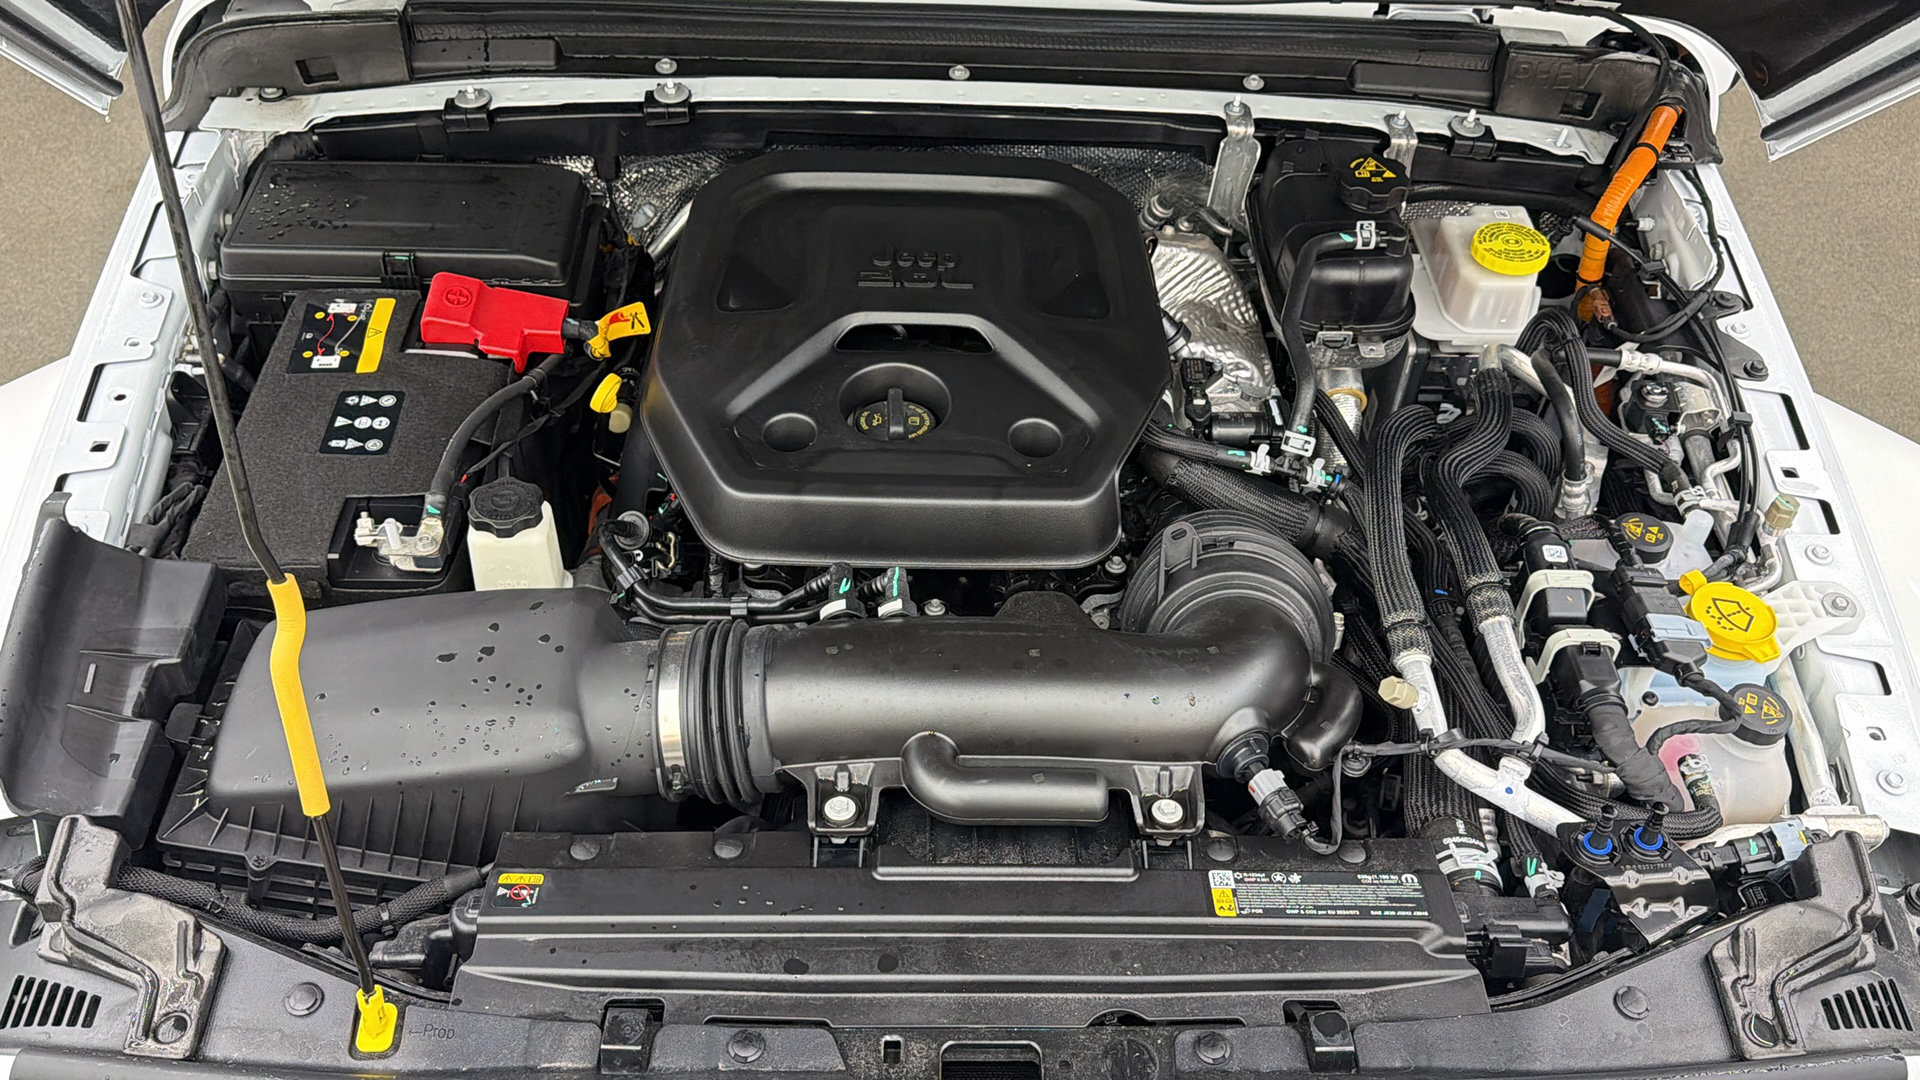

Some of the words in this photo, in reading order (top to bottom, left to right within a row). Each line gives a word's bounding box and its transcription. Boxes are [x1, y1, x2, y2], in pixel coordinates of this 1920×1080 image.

[1509, 61, 1600, 89] PHEV
[872, 249, 956, 271] Jeep
[423, 1024, 455, 1041] Prop
